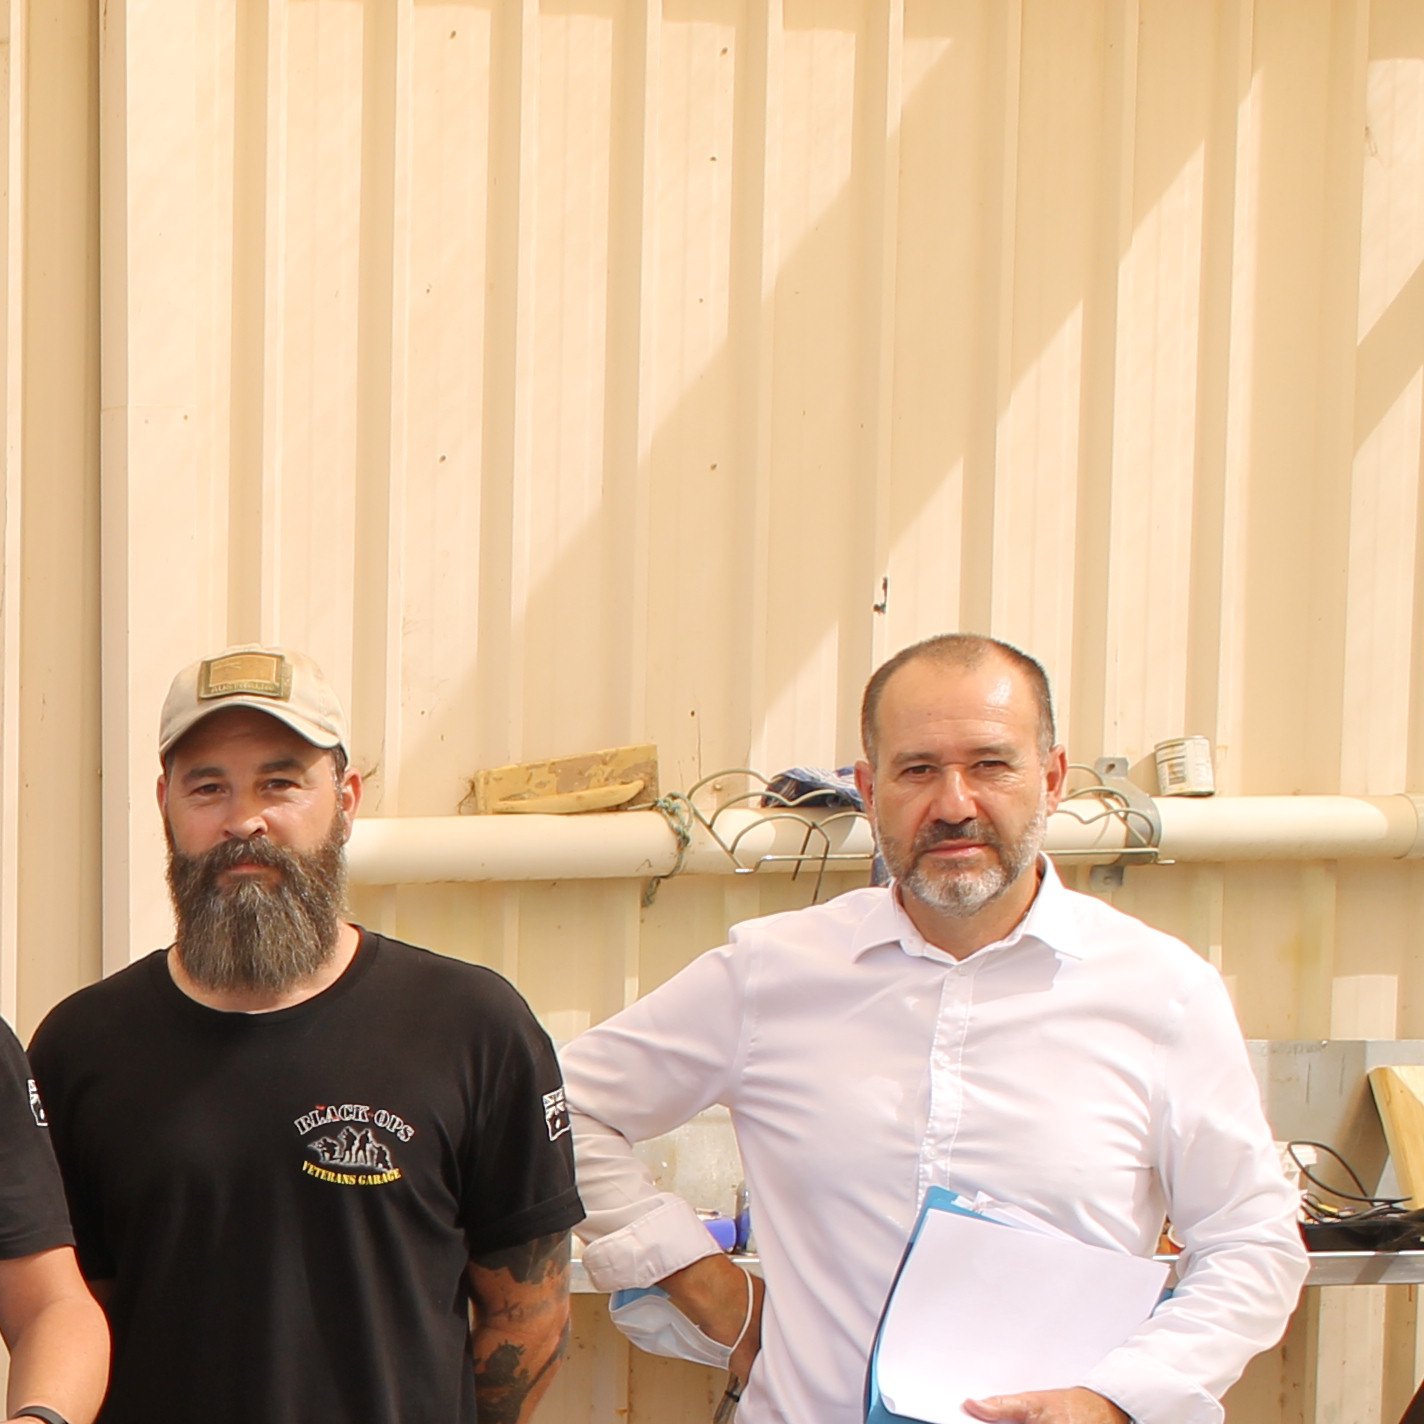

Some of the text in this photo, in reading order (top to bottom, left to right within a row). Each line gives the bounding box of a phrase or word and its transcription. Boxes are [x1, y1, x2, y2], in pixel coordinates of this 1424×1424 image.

[294, 1104, 415, 1143] BLACK OPS
[302, 1160, 402, 1186] VETERANS GARAGE
